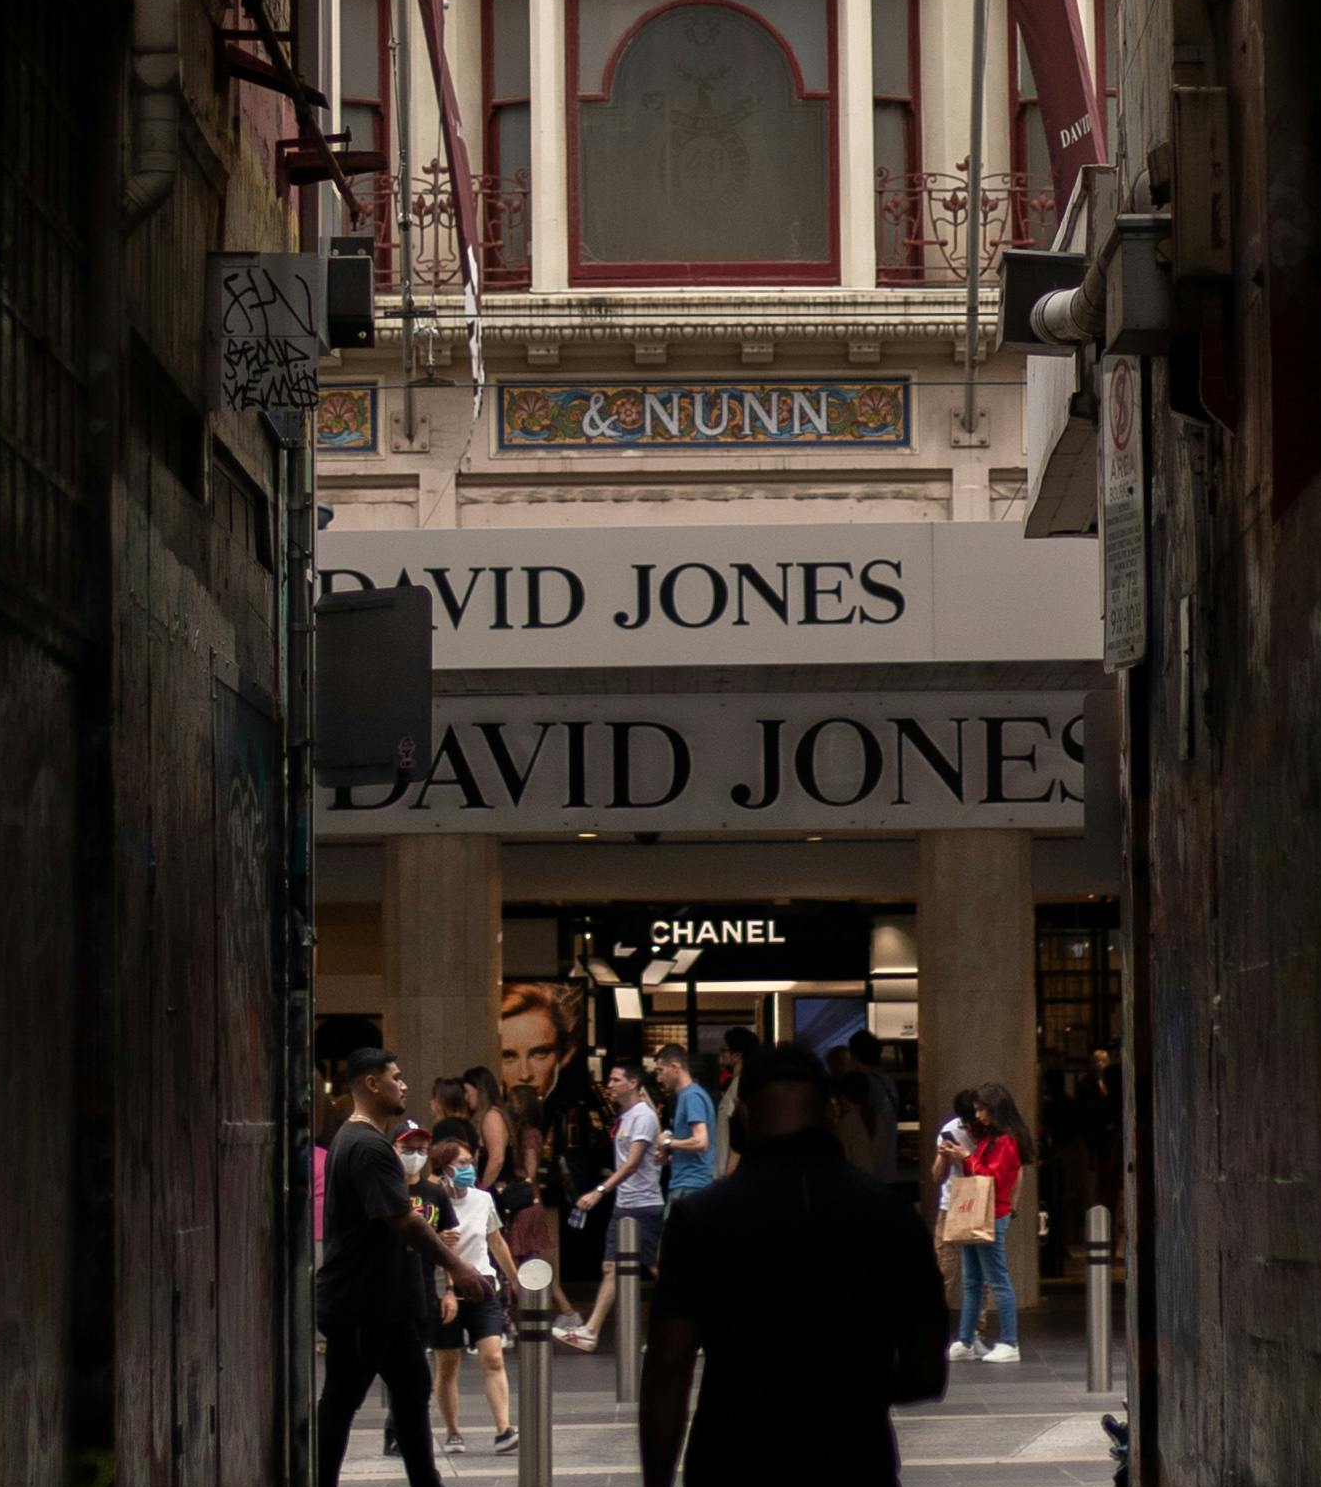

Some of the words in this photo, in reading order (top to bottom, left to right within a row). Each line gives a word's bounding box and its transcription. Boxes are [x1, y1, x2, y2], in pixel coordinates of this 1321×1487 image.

[582, 391, 621, 437] &
[643, 391, 831, 436] NUNN
[614, 560, 906, 628] JONES
[651, 919, 786, 945] CHANEL
